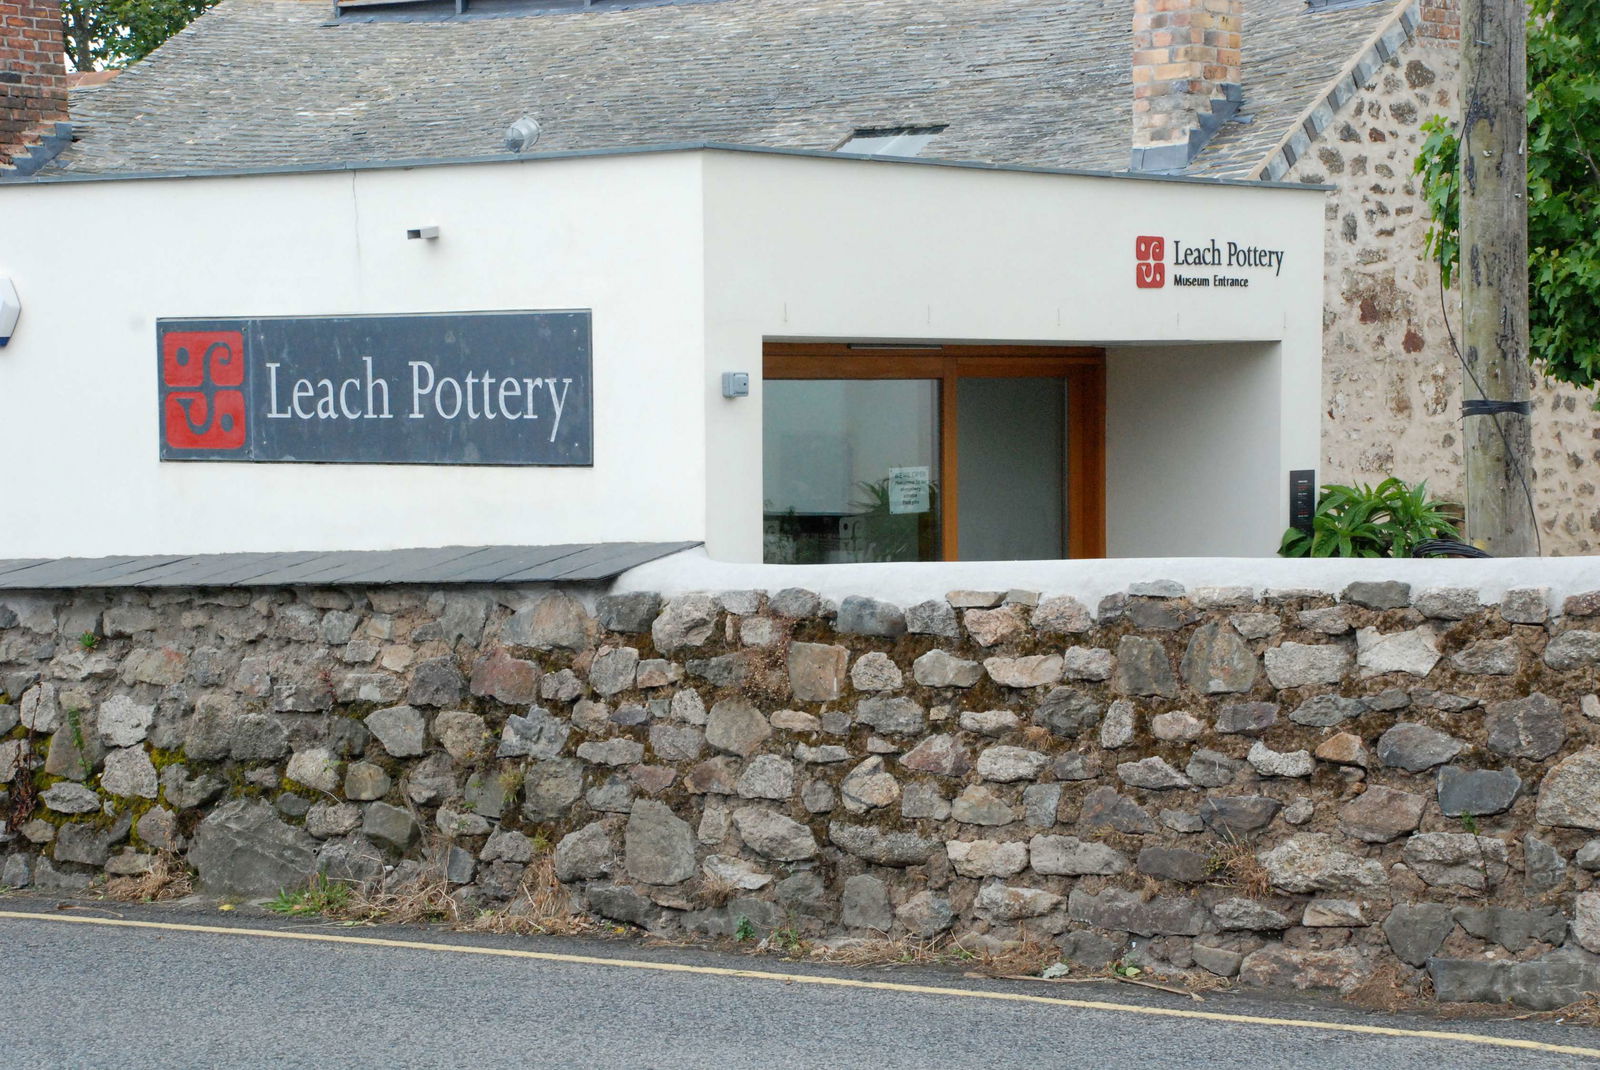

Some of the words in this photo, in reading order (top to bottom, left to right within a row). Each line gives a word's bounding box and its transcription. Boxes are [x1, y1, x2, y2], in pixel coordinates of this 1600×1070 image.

[1174, 239, 1222, 266] Leach
[1227, 241, 1284, 276] Pottery
[1174, 274, 1210, 287] Museum
[1213, 275, 1249, 287] Entrance
[266, 356, 394, 420] Leach
[408, 361, 573, 442] Pottery
